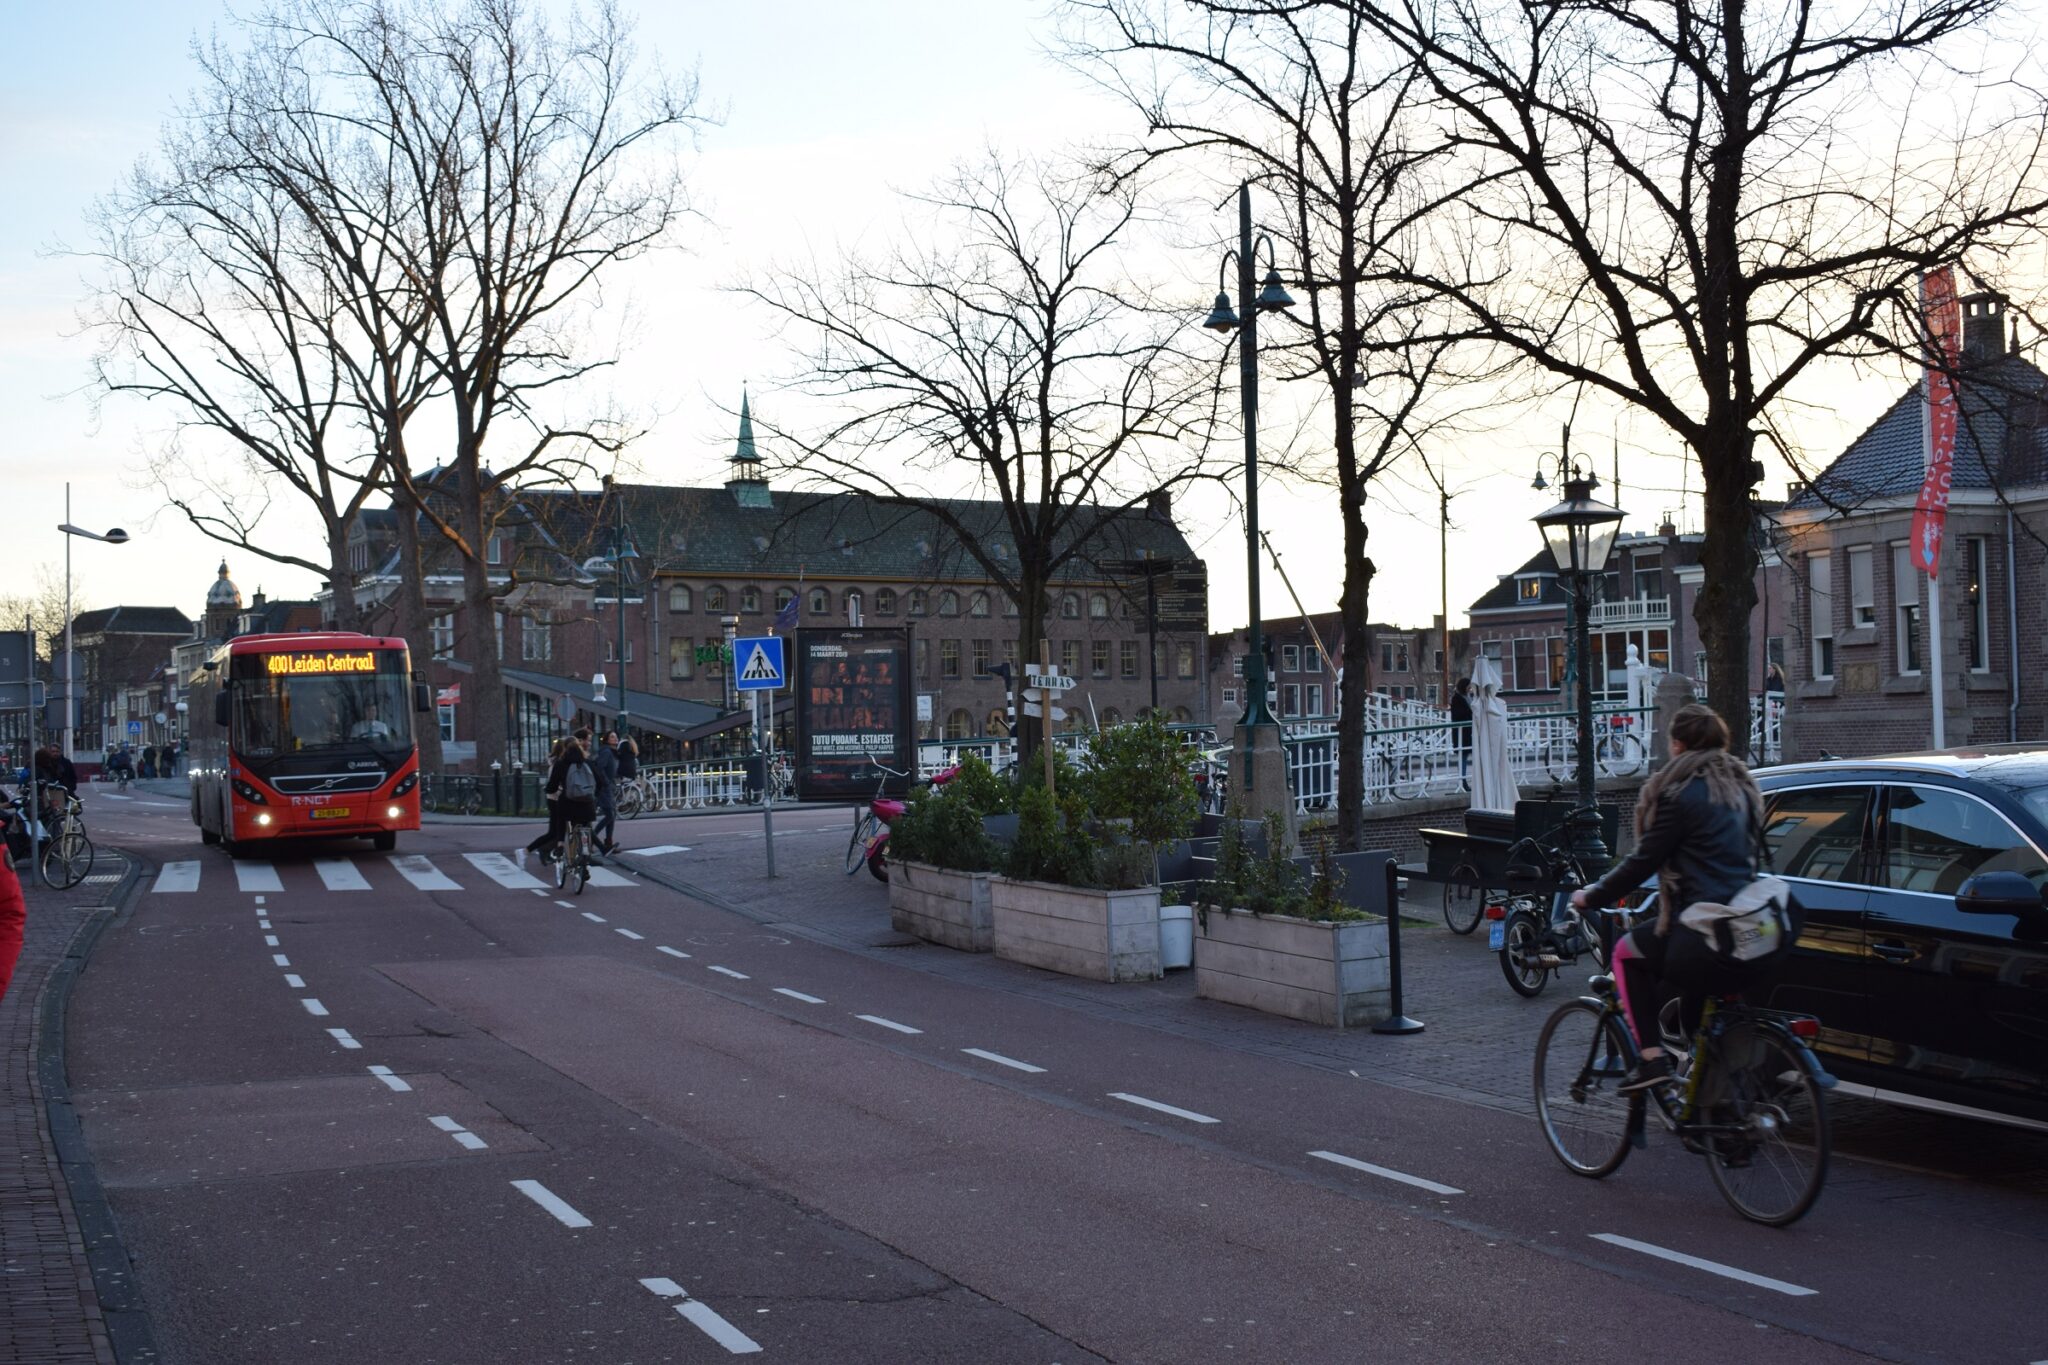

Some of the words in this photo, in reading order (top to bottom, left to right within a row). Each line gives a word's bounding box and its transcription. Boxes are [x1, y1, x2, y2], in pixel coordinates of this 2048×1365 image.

[268, 655, 288, 674] 400
[288, 654, 326, 673] Leiden
[327, 652, 375, 672] Centraal
[1031, 675, 1071, 688] TERRAS
[812, 735, 830, 745] TUTU
[861, 734, 894, 745] ESTAFEST
